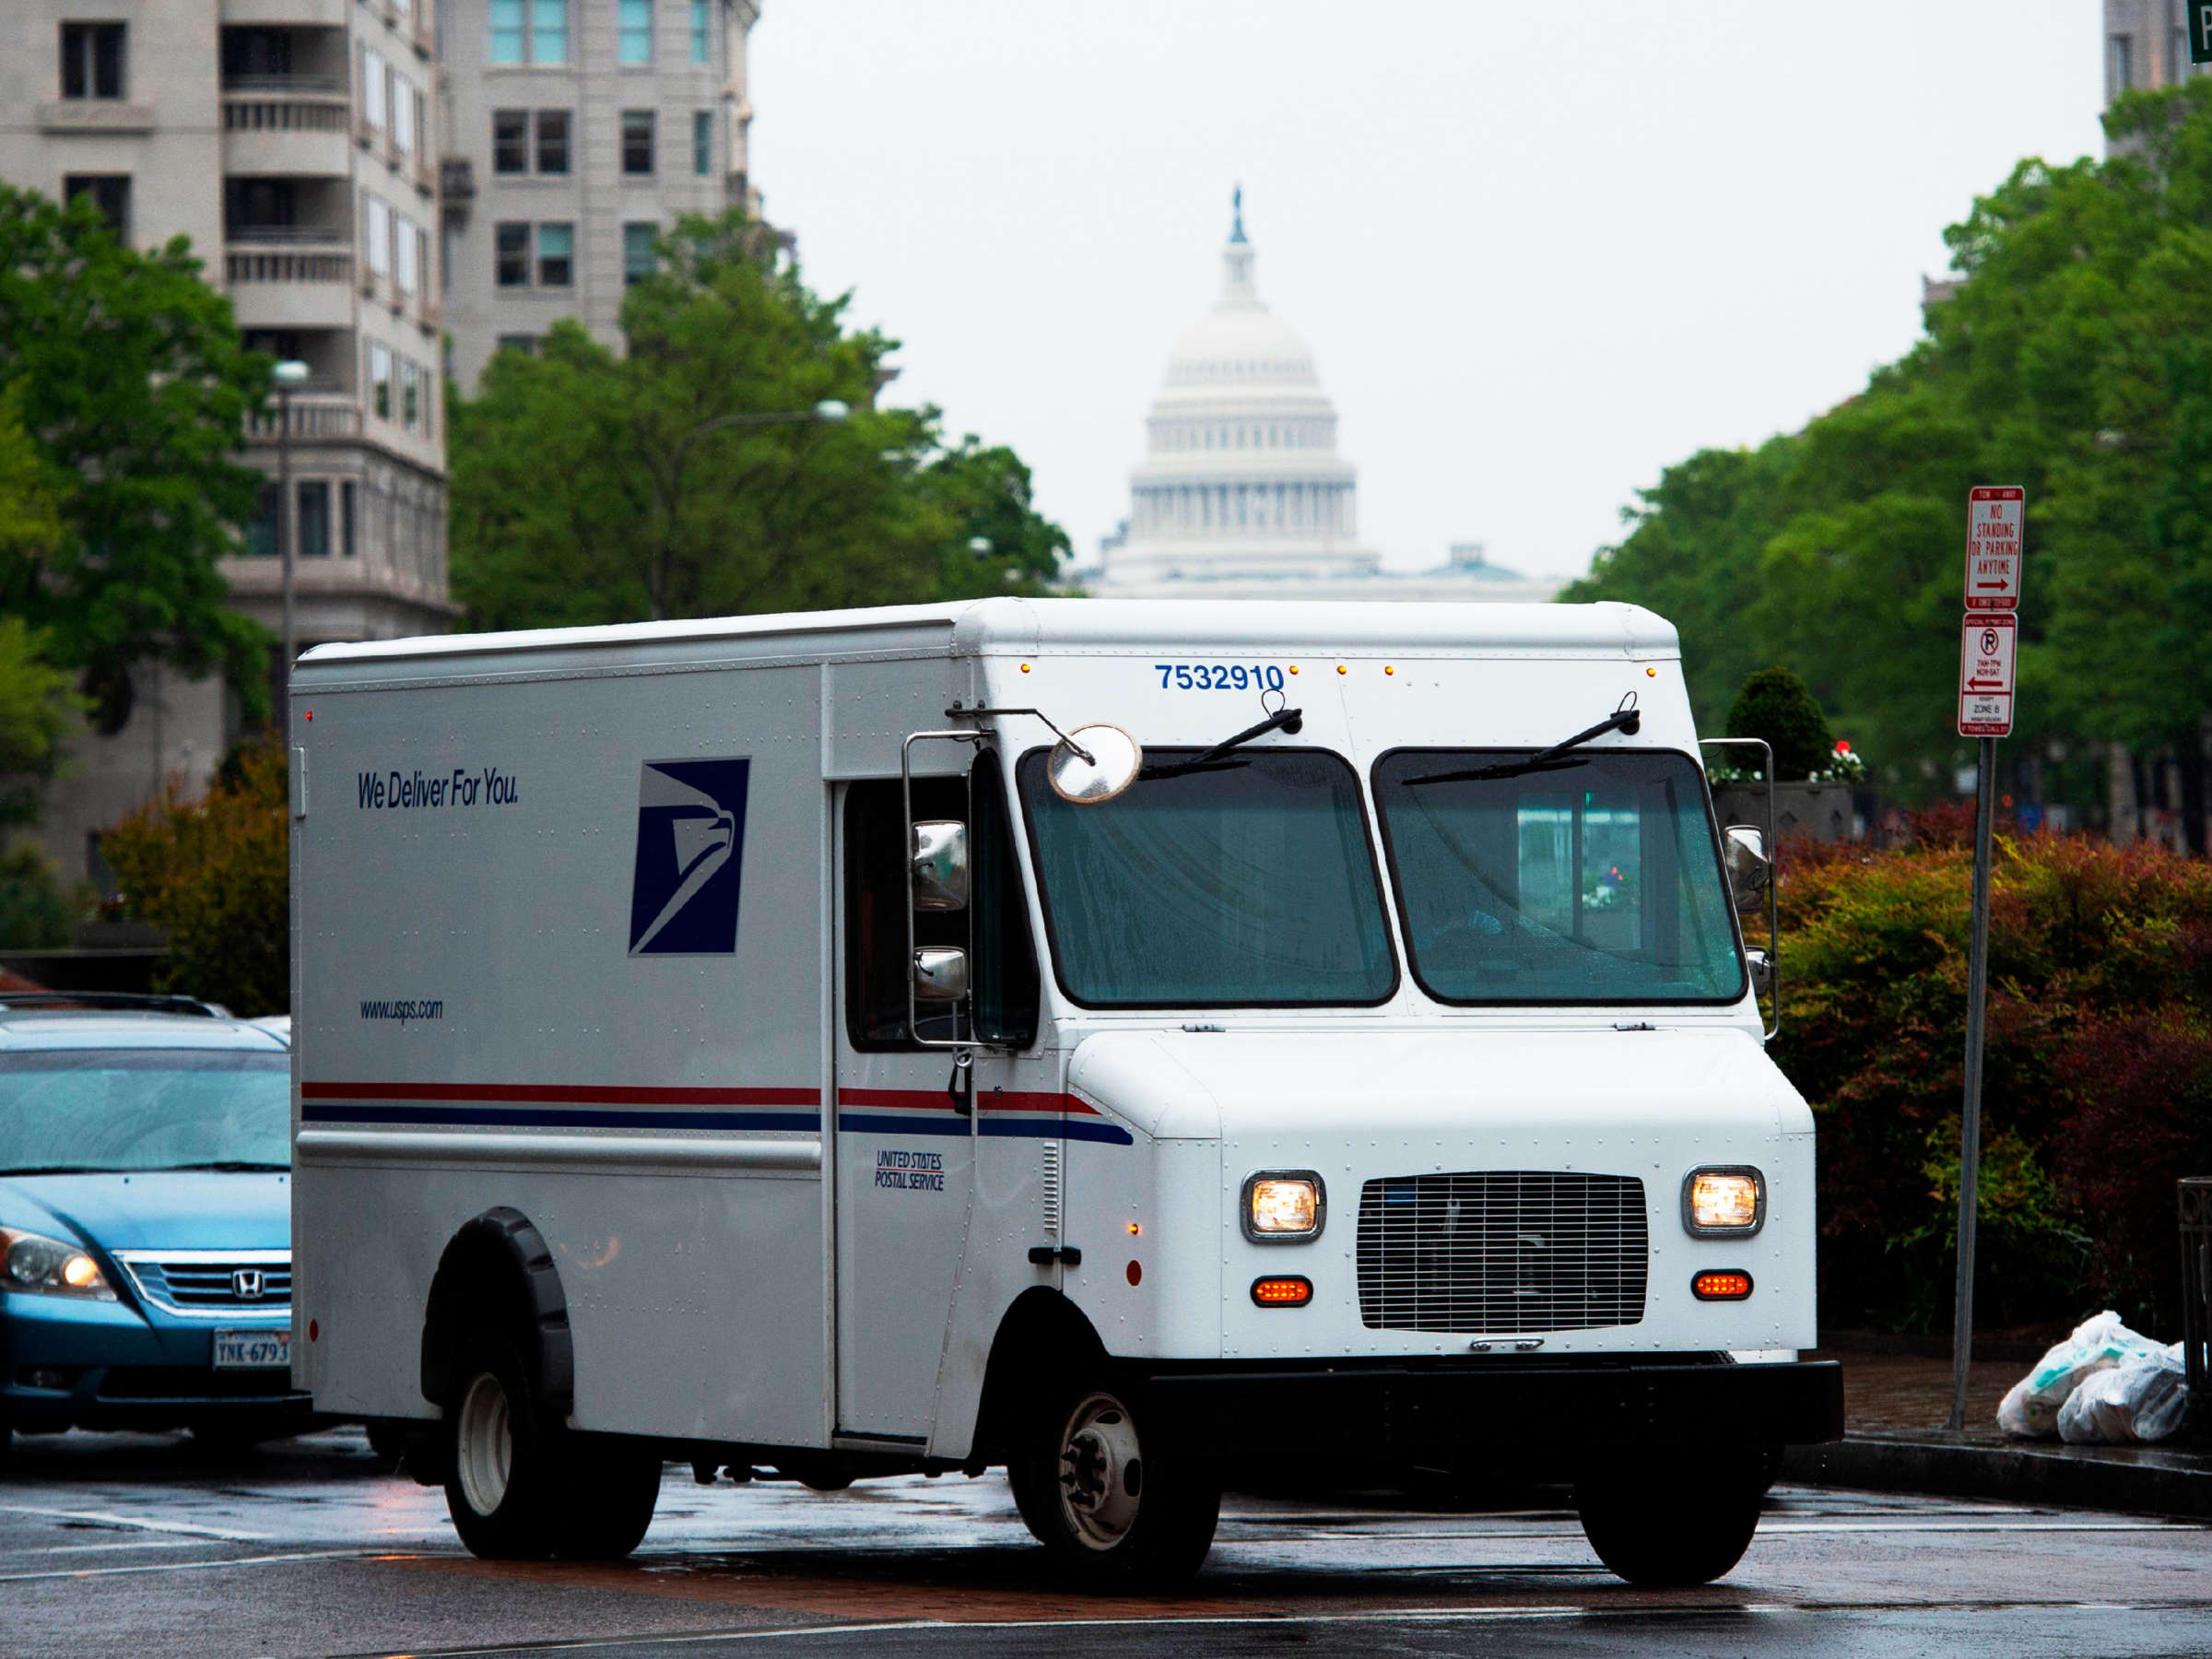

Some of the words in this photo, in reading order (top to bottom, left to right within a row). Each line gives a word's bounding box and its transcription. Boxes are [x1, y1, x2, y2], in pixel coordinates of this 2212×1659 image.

[1990, 503, 2003, 519] NO
[1976, 523, 2015, 537] STANDING
[1971, 540, 1982, 557] OR
[1985, 540, 2018, 556] PARKING
[1977, 559, 2010, 575] ANYTIME
[1154, 665, 1285, 690] 7532910
[359, 771, 385, 809] We
[388, 771, 449, 808] Deliver
[451, 769, 481, 806] For
[484, 767, 518, 805] You.
[360, 1000, 442, 1025] www.usps.com
[877, 1149, 911, 1168] UNITED
[911, 1151, 942, 1171] STATES
[875, 1171, 908, 1189] POSTAL
[909, 1172, 945, 1192] SERVICE
